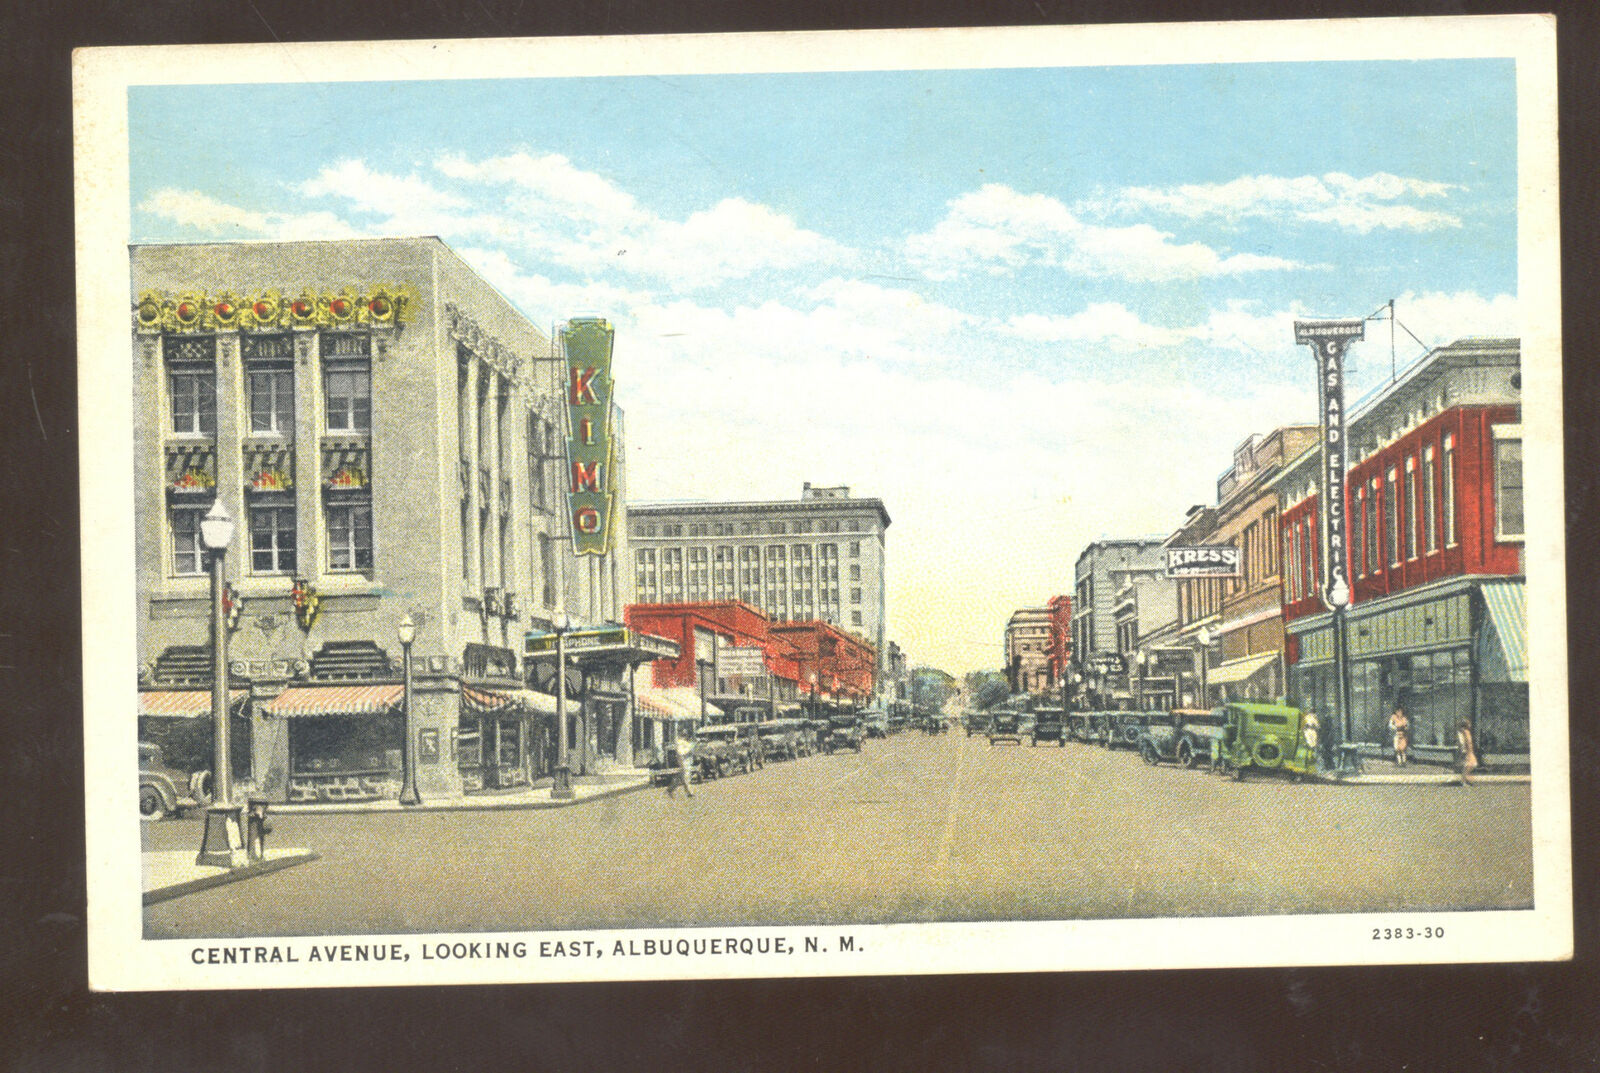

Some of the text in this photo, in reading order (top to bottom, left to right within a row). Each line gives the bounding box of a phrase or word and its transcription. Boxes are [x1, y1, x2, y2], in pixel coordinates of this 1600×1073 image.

[569, 366, 602, 535] KIMO
[1325, 340, 1342, 581] GAS AND ELECTRIC
[1168, 549, 1236, 568] KRESS
[1372, 926, 1445, 940] 2383-30
[191, 935, 864, 965] CENTRAL AVENUE, LOOKING EAST, ALBUQUERQUE, N. M.
